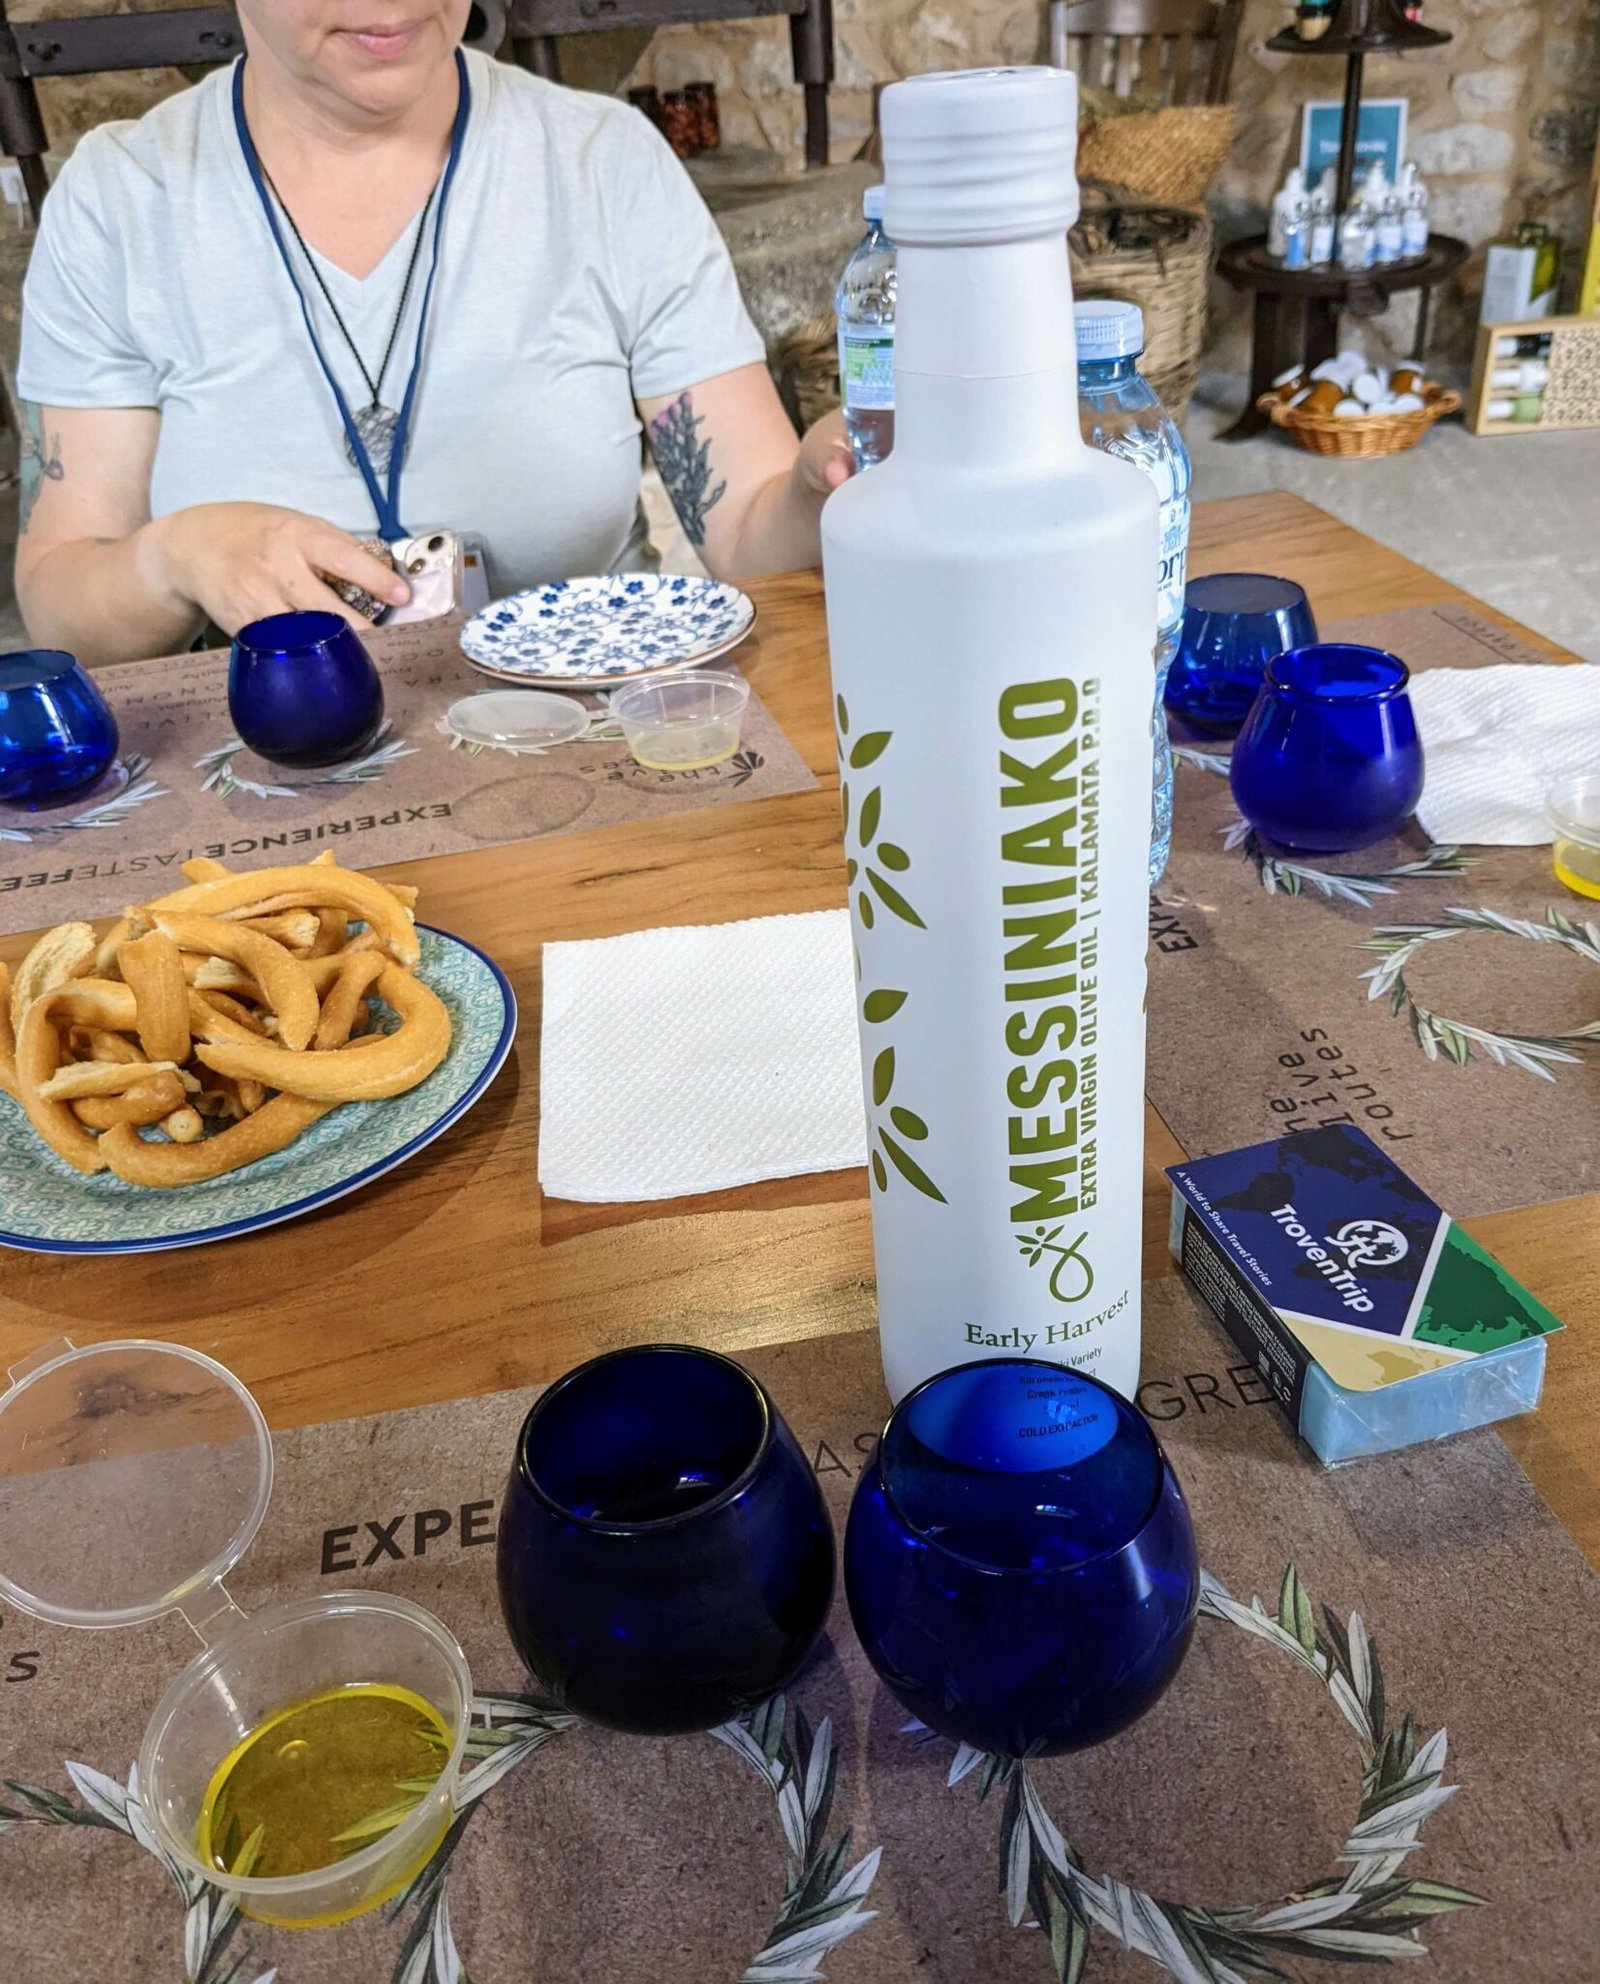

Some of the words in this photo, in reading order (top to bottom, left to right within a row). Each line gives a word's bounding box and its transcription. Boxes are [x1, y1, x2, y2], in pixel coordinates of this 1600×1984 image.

[1080, 758, 1100, 903] KALAMATA
[998, 678, 1079, 1223] MESSINIAKO
[1080, 926, 1099, 970] OIL
[1080, 975, 1098, 1047] OLIVE
[1080, 1053, 1098, 1136] VIRGIN
[1300, 1028, 1414, 1141] routes
[1080, 1137, 1098, 1211] EXTRA
[1176, 1170, 1186, 1179] A
[1184, 1177, 1206, 1203] World
[1201, 1200, 1212, 1212] to
[1208, 1210, 1230, 1235] Share
[1226, 1233, 1252, 1260] Travel
[1245, 1253, 1273, 1287] Stories
[1270, 1203, 1374, 1313] TrovenTrip
[964, 1322, 1039, 1353] Early
[1045, 1289, 1129, 1345] Harvest
[1070, 1347, 1103, 1367] Variety
[1138, 1365, 1277, 1421] GRE
[320, 1499, 497, 1576] EXPE
